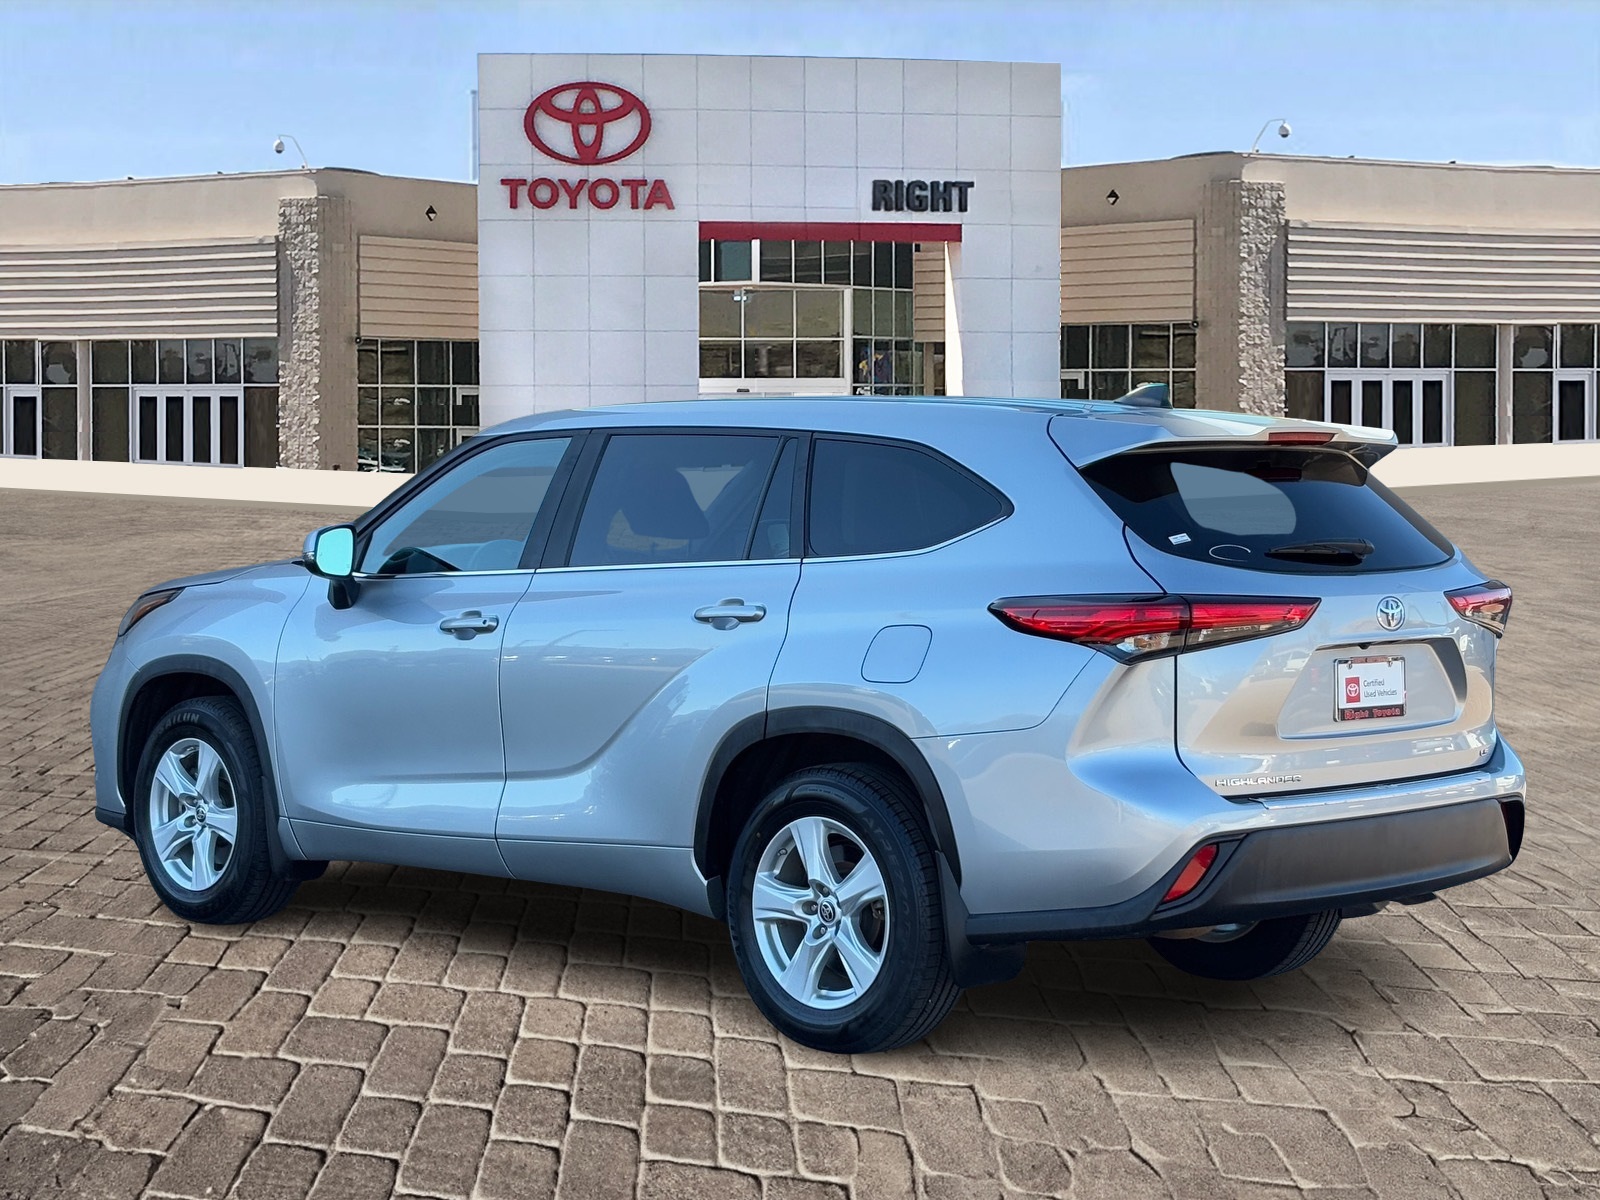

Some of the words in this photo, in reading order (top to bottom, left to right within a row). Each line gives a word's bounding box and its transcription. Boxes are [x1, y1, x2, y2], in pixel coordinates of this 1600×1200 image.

[500, 177, 675, 209] TOYOTA
[871, 179, 975, 212] RIGHT
[1362, 678, 1385, 688] Certified
[1363, 689, 1377, 698] Used
[1377, 688, 1398, 697] Vehicles
[1344, 709, 1369, 719] Right
[1372, 707, 1401, 717] Toyota
[1214, 774, 1302, 787] HIGHLANDER
